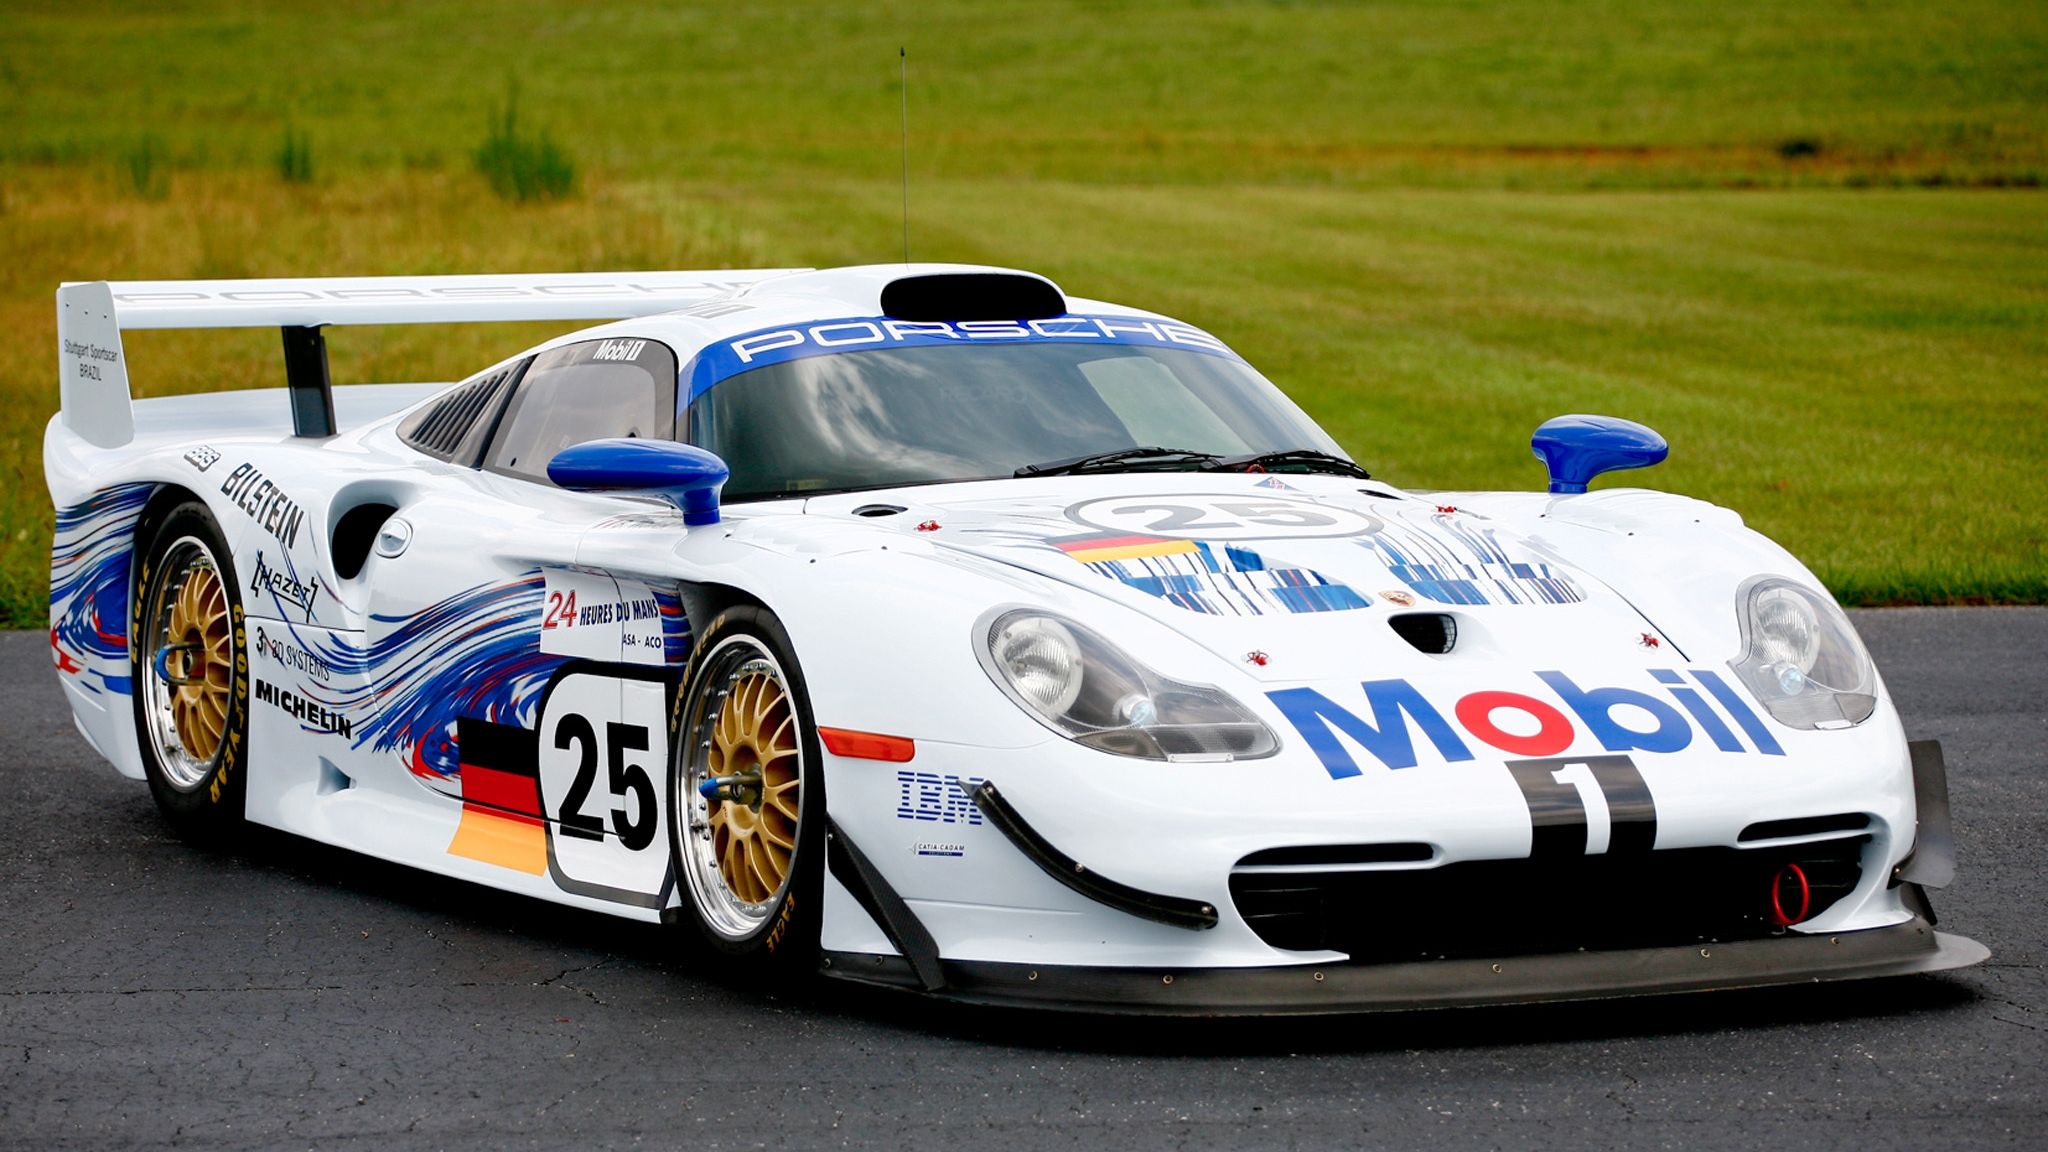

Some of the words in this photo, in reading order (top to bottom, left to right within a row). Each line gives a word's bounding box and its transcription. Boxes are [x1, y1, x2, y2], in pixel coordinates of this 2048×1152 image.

[64, 339, 89, 359] Stuttgart
[90, 344, 118, 362] Sportscar
[592, 340, 636, 361] Mobil
[731, 318, 1230, 363] PORSCHE
[80, 363, 102, 381] BRAZIL
[183, 445, 221, 472] BBS
[220, 462, 304, 549] BILSTEIN
[1111, 503, 1338, 531] 25
[542, 588, 578, 630] 24
[579, 604, 613, 626] HEURES
[616, 601, 630, 622] DU
[632, 599, 659, 620] MANS
[271, 639, 285, 662] 3D
[286, 645, 331, 682] SYSTEMS
[644, 636, 662, 649] ACO
[255, 678, 352, 740] MICHELIN
[1264, 669, 1787, 780] Mobil
[554, 713, 659, 851] 25
[897, 771, 984, 825] IBM
[766, 891, 796, 954] EAGLE
